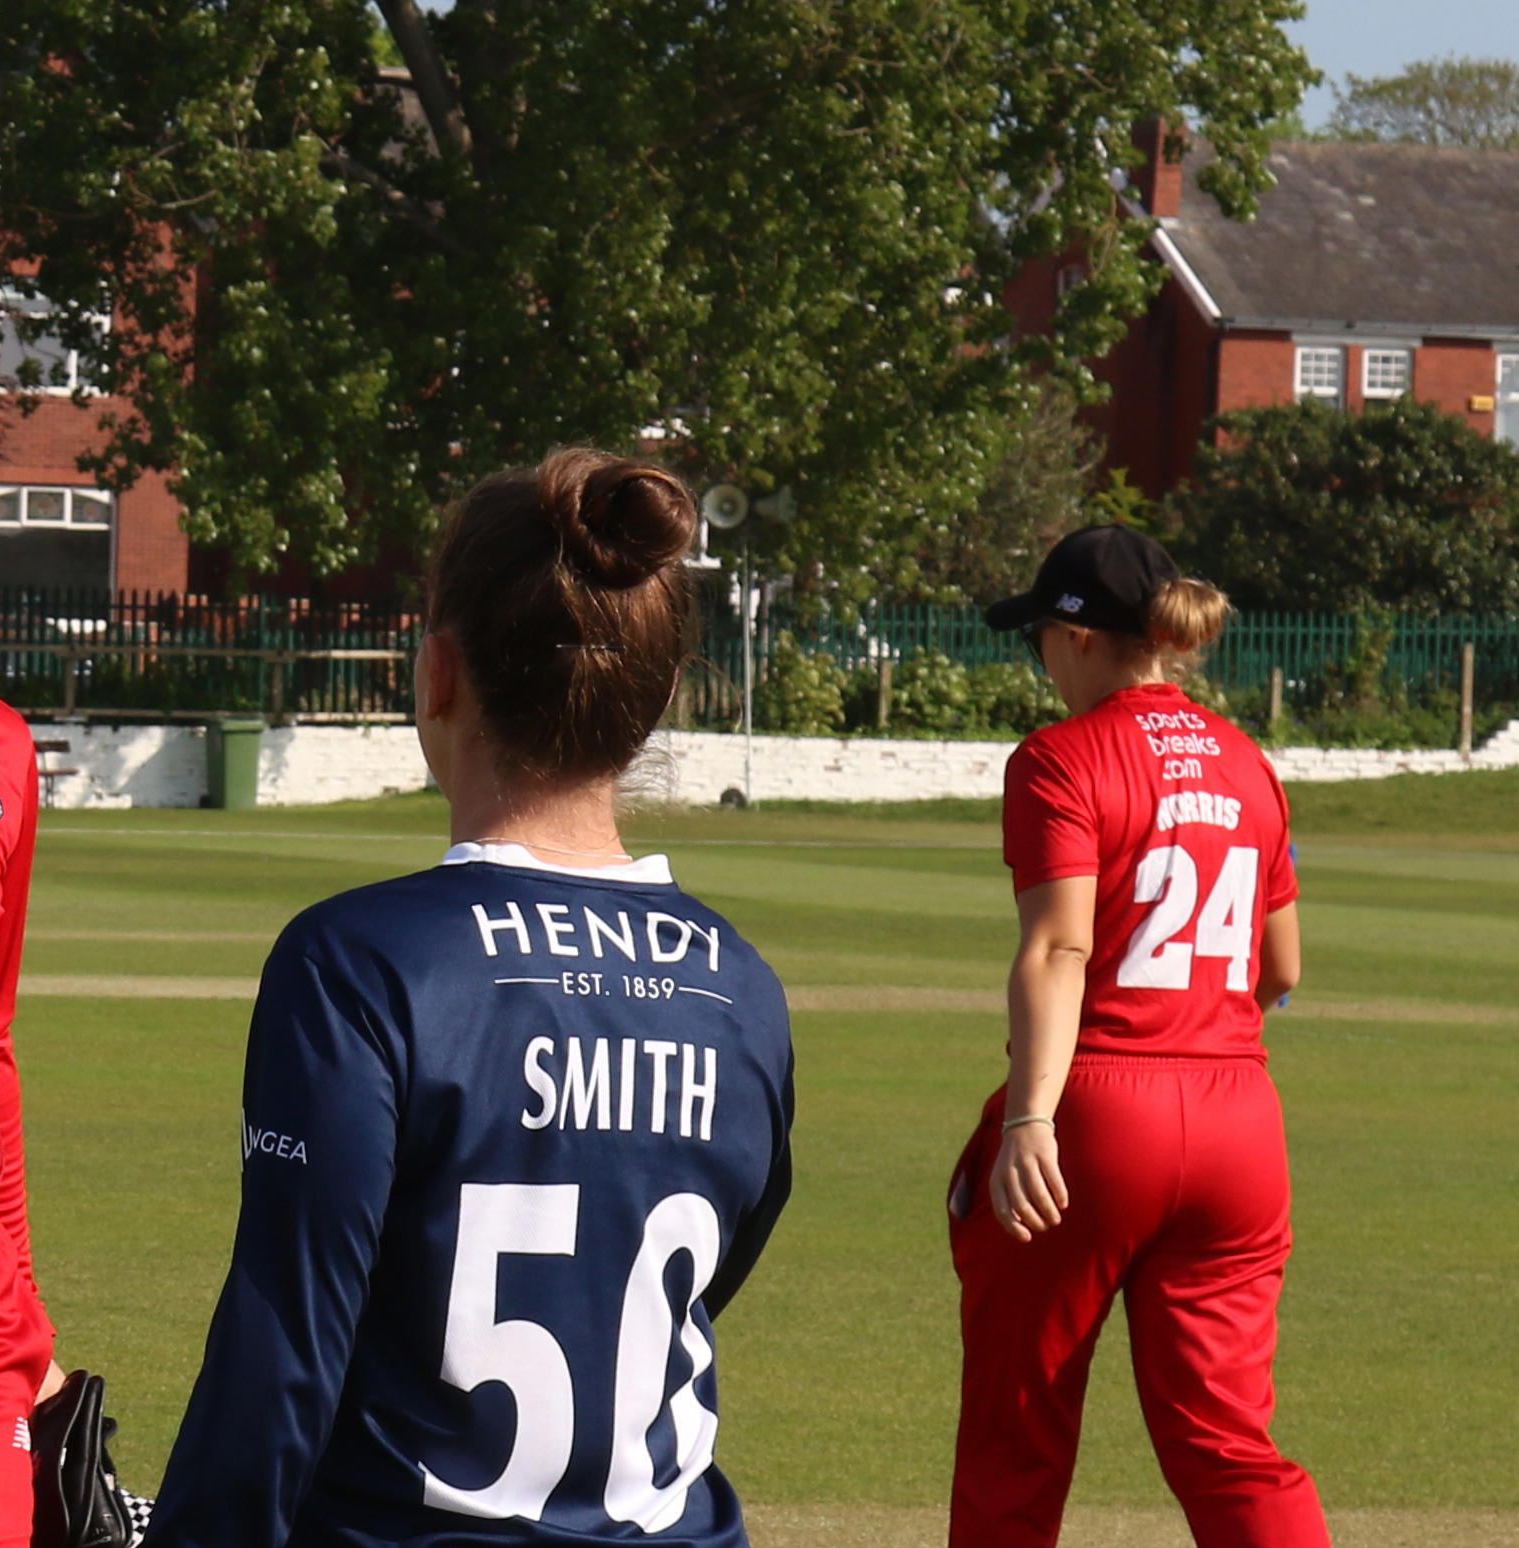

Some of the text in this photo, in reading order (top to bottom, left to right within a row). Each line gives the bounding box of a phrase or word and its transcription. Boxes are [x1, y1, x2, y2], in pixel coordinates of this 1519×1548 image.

[1135, 709, 1206, 733] sports
[1146, 732, 1221, 757] breaks
[1156, 791, 1243, 832] NORRIS
[471, 901, 720, 972] HENDY
[1116, 844, 1260, 992] 24
[562, 971, 676, 1000] EST. 1859
[521, 1035, 717, 1142] SMITH
[418, 1182, 721, 1535] 50
